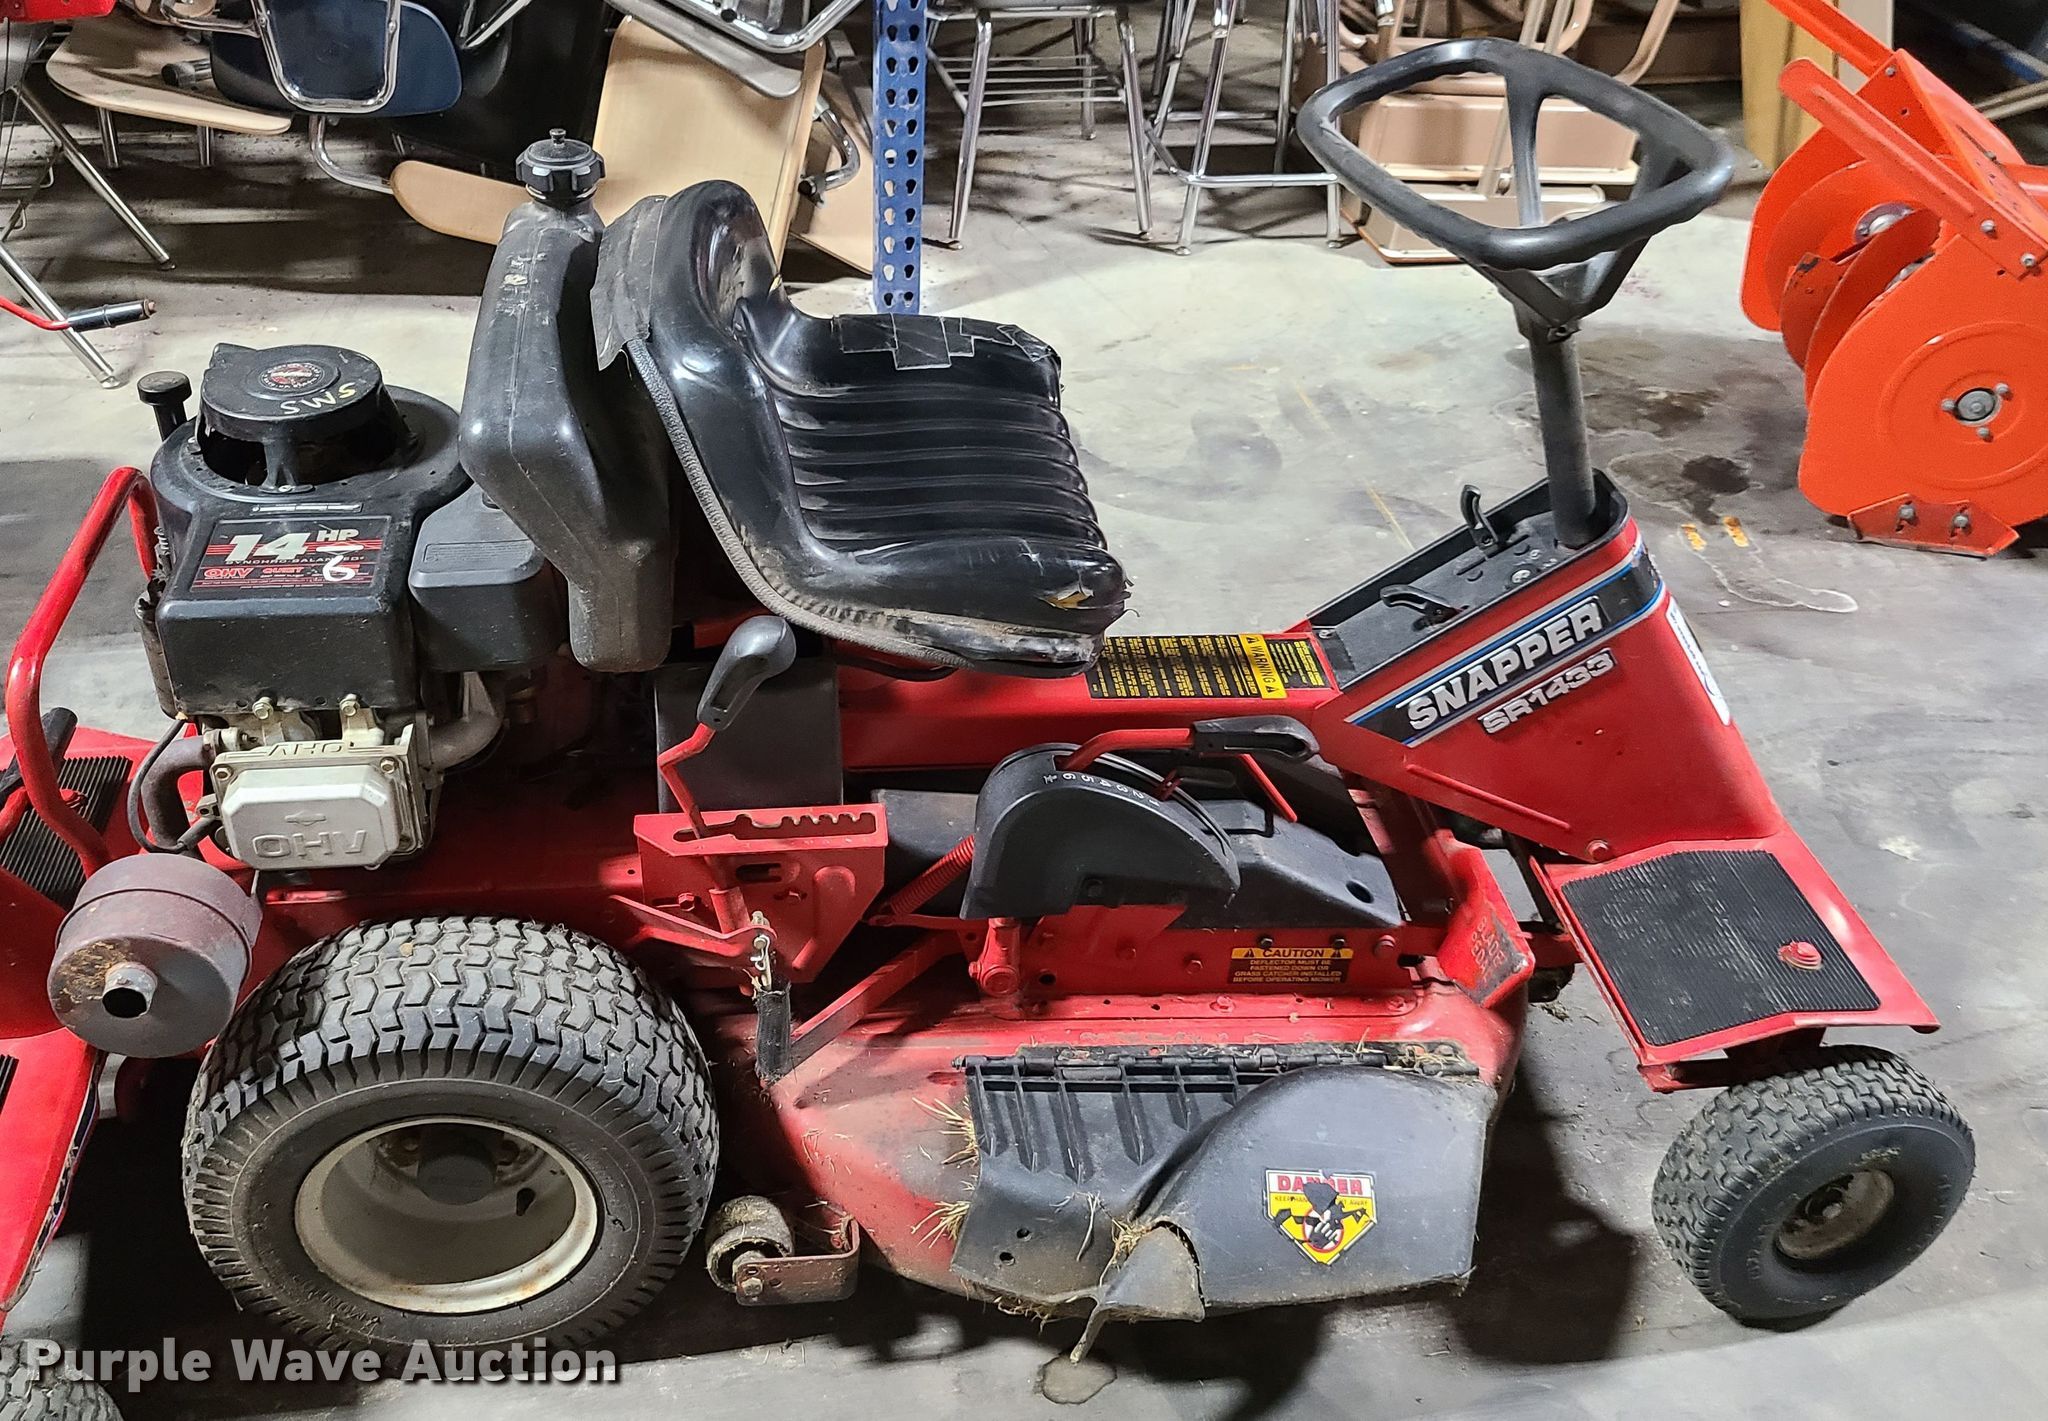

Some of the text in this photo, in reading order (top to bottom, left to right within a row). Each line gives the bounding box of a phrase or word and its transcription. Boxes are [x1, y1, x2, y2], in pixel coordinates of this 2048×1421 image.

[280, 381, 357, 415] SWS
[223, 528, 360, 561] 14 HP
[225, 555, 359, 564] SYNCHRO-BALANED
[204, 567, 254, 579] OHV
[1250, 646, 1276, 684] WARNING
[1408, 602, 1602, 731] SNAPPER
[1483, 653, 1614, 734] SR1433
[252, 829, 369, 858] OHV
[1262, 949, 1324, 958] CAUTION
